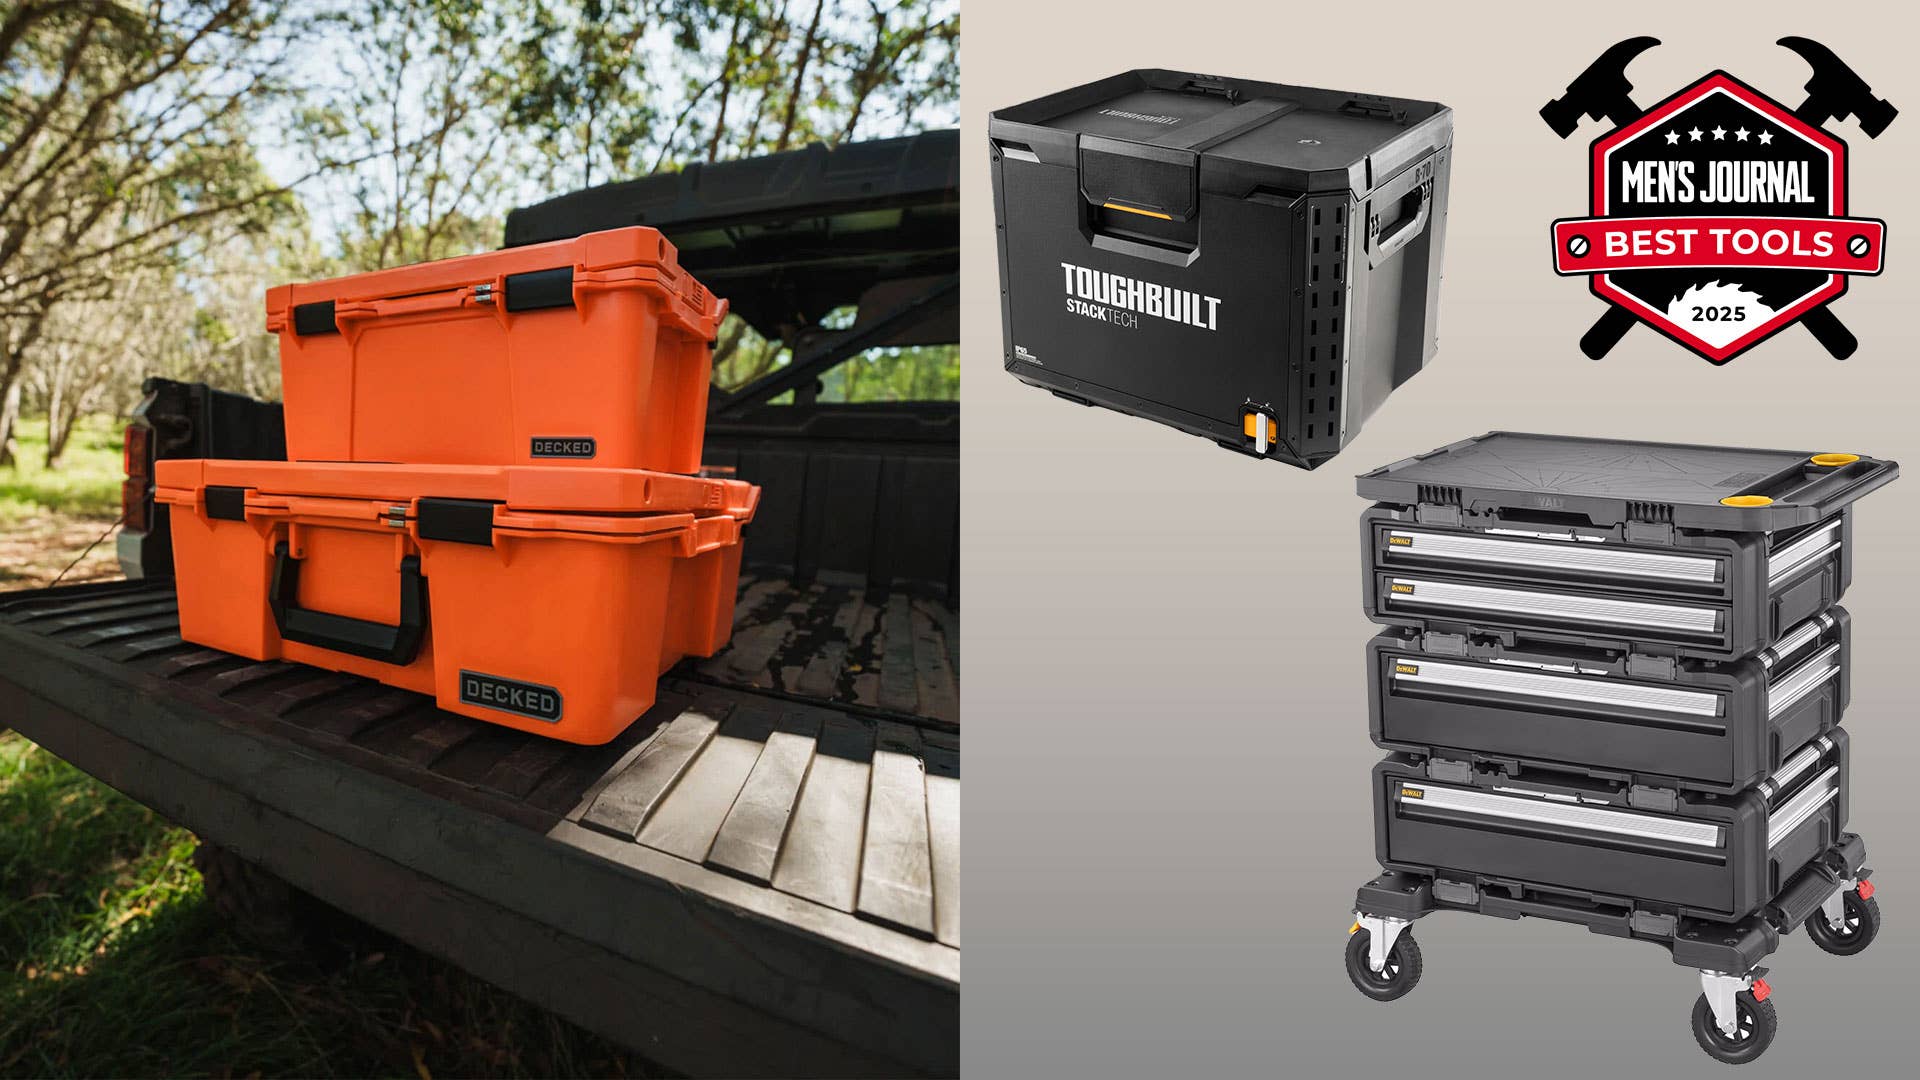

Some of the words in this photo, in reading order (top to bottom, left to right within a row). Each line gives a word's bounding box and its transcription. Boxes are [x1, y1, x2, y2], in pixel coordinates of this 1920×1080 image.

[1061, 262, 1222, 331] TOUGHBUILT
[1066, 298, 1138, 329] STACKTECH
[535, 441, 592, 454] DECKED
[467, 679, 555, 713] DECKED
